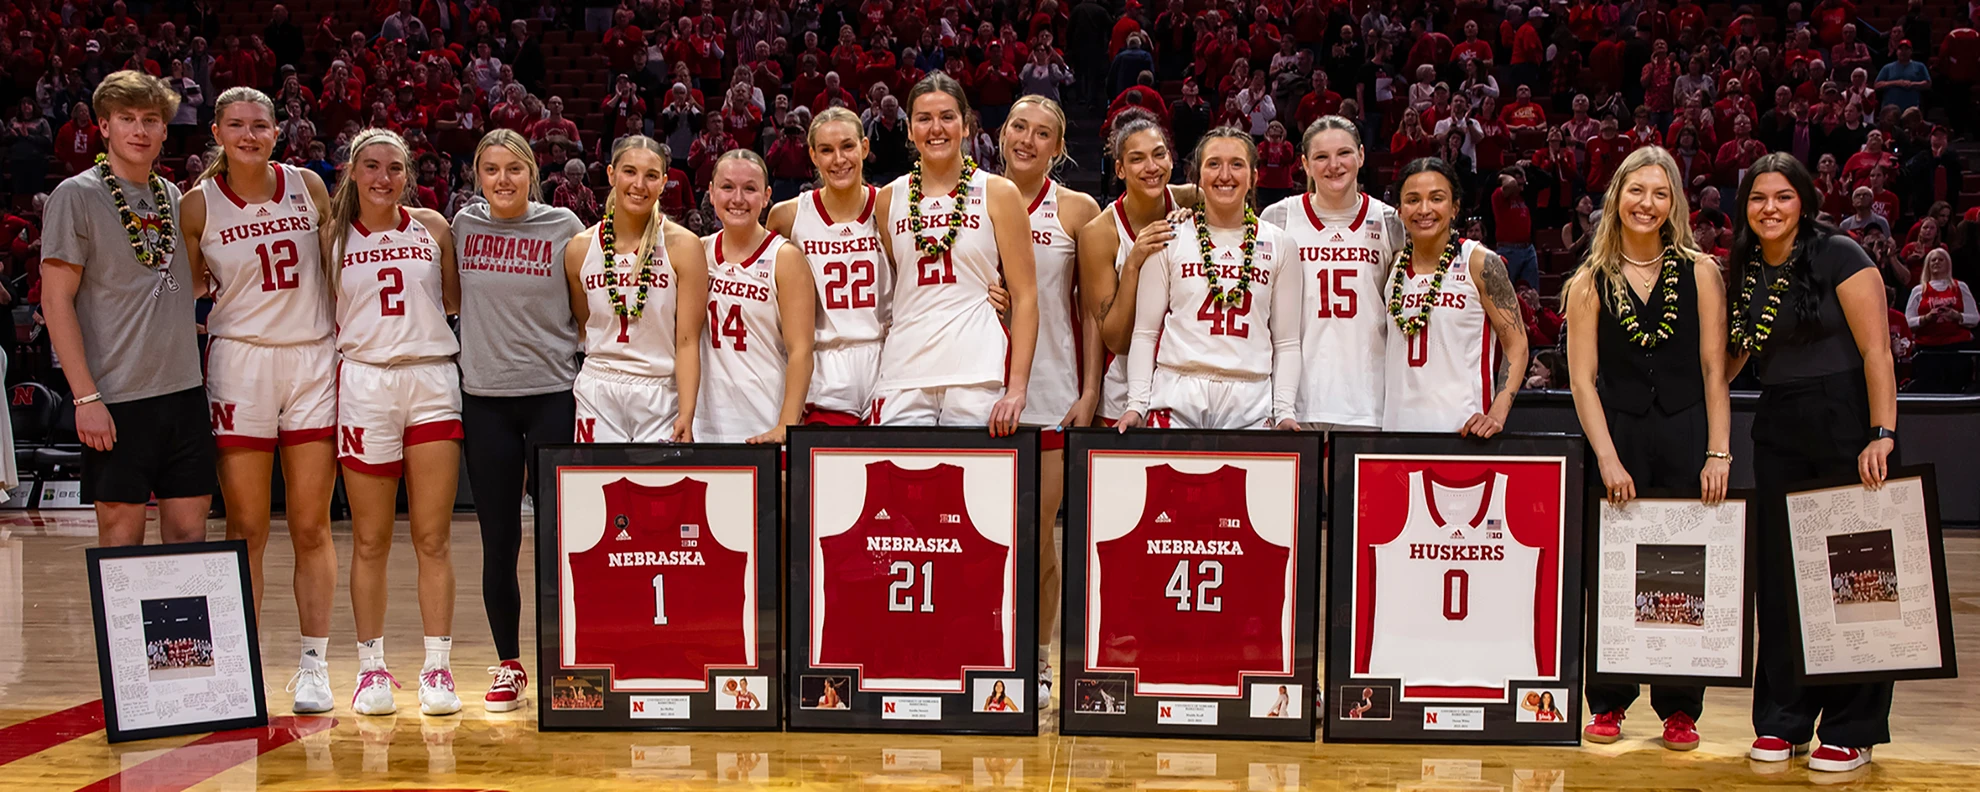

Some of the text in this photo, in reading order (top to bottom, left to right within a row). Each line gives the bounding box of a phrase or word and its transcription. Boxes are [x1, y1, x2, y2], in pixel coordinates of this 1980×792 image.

[220, 216, 311, 246] HUSKERS
[803, 236, 882, 255] HUSKER
[255, 239, 299, 292] 12
[342, 246, 433, 269] HUSKERS
[915, 235, 957, 287] 21
[377, 267, 405, 317] 2
[708, 277, 769, 302] USKERS
[823, 260, 875, 310] 22
[1317, 268, 1358, 318] 15
[616, 294, 630, 343] 1
[708, 300, 747, 352] 14
[1196, 285, 1253, 339] 42
[1408, 316, 1428, 367] 0
[12, 386, 35, 406] N
[211, 401, 237, 431] N
[577, 418, 597, 443] N
[341, 425, 365, 455] N
[608, 551, 706, 567] NEBRASKA
[867, 536, 963, 553] NEBRASKA
[1147, 540, 1244, 555] NEBRASKA
[1409, 543, 1505, 561] HUSKERS
[652, 573, 668, 625] 1
[889, 560, 934, 612] 21
[1165, 560, 1223, 612] 42
[1443, 569, 1469, 621] 0
[633, 701, 645, 712] N
[884, 702, 896, 713] N
[1160, 706, 1171, 718] N
[1426, 712, 1437, 724] N
